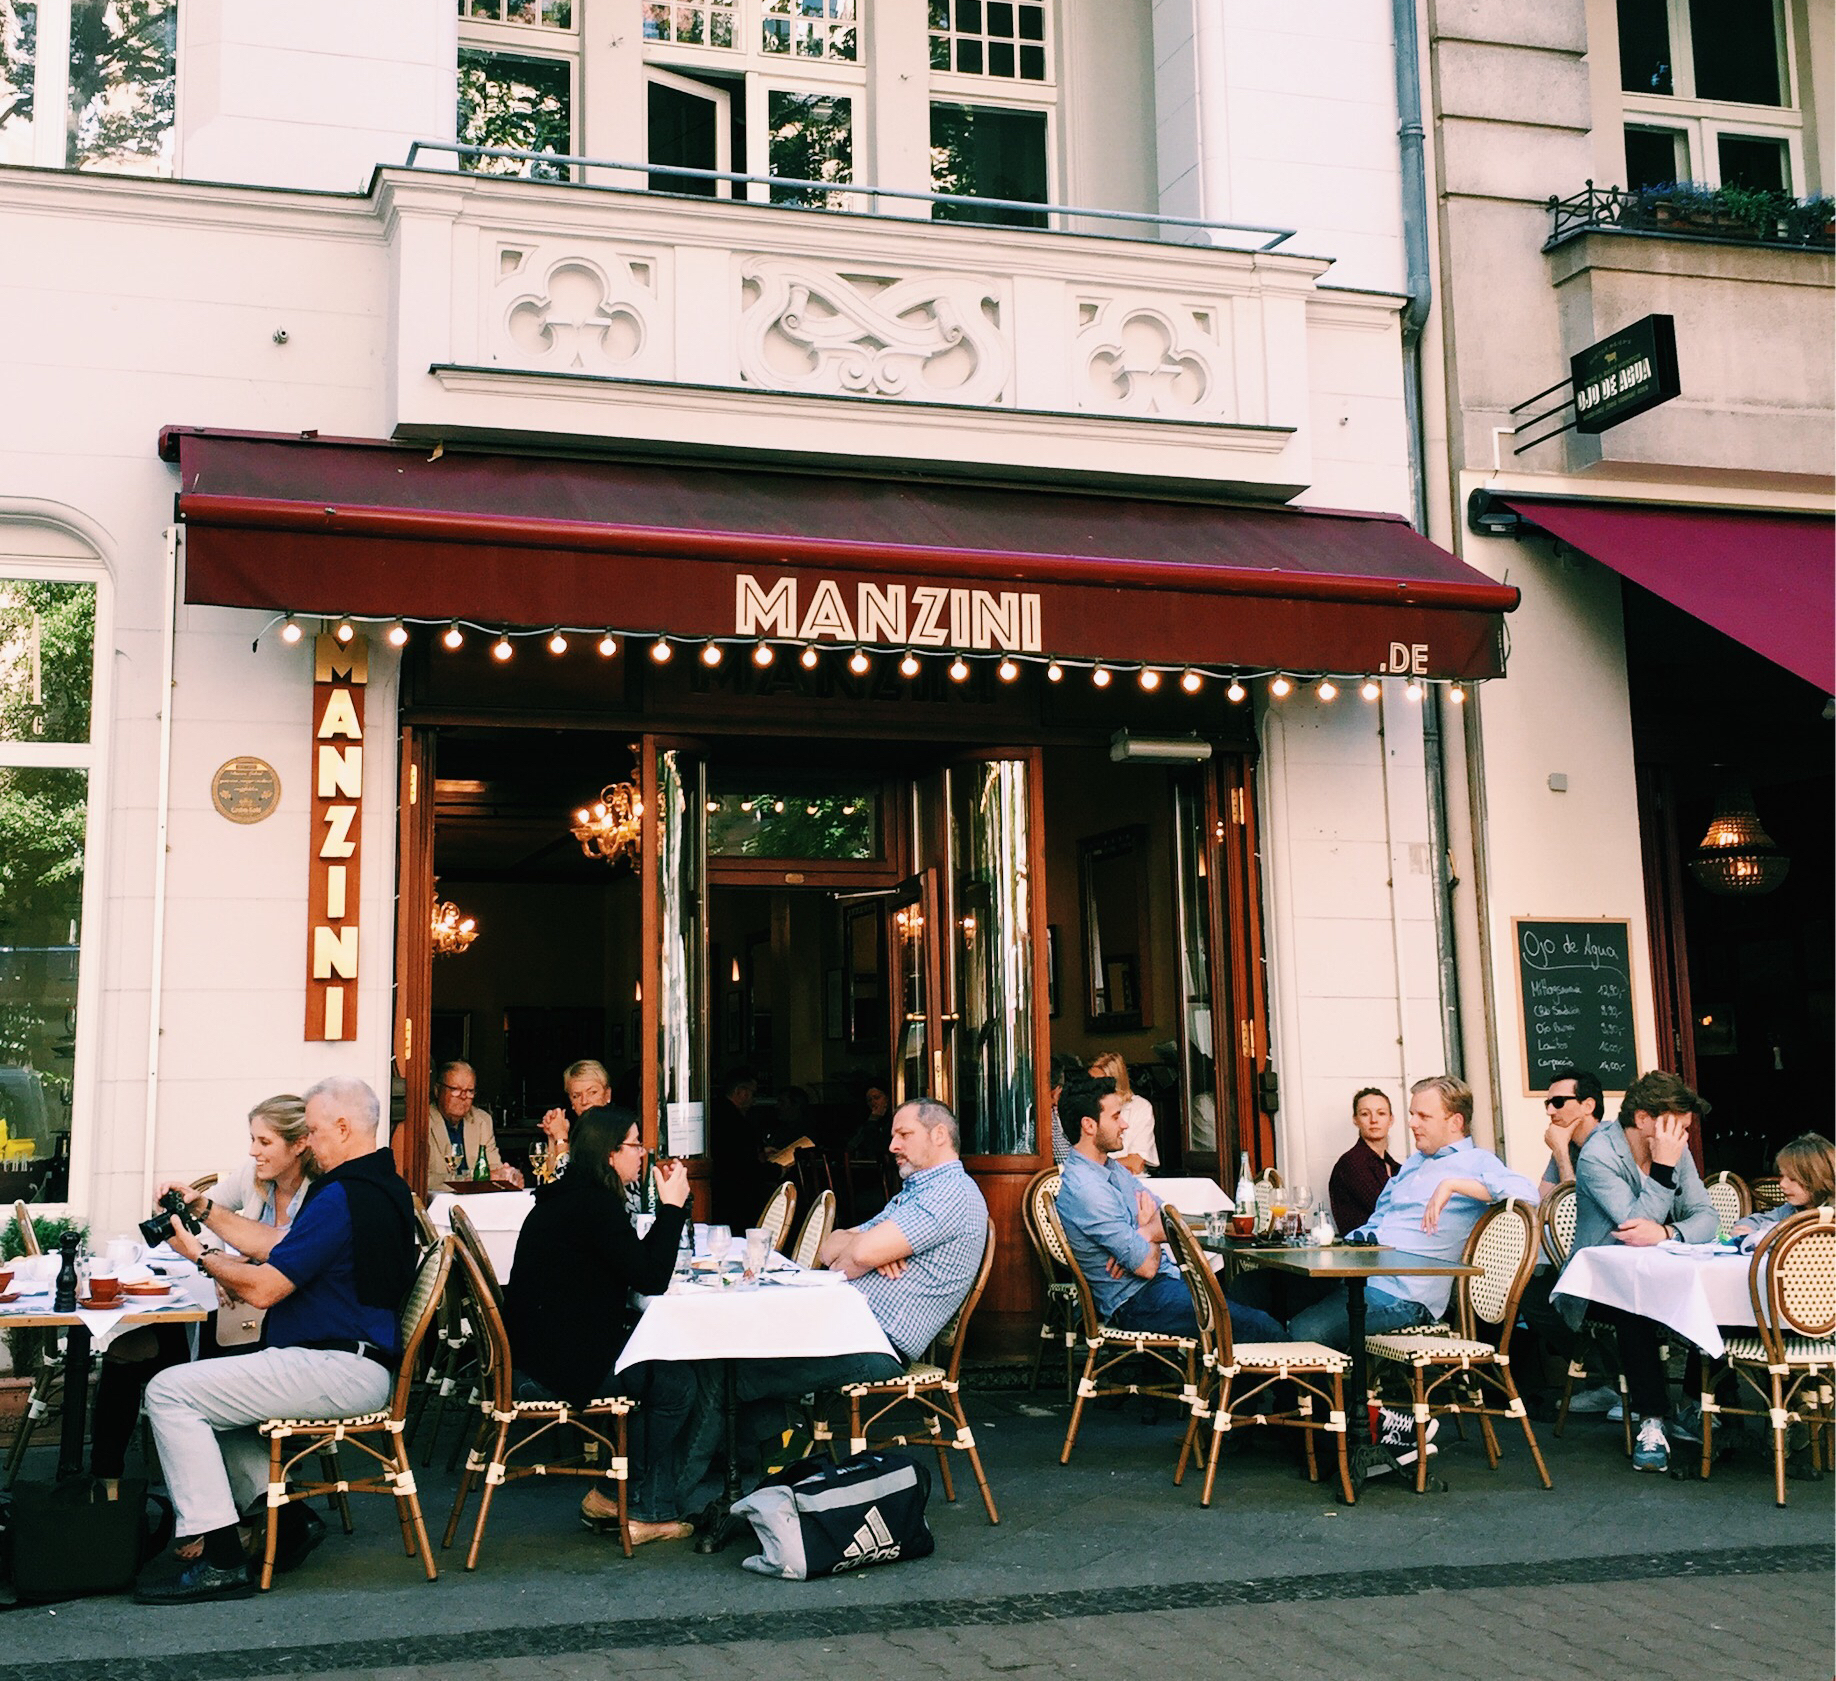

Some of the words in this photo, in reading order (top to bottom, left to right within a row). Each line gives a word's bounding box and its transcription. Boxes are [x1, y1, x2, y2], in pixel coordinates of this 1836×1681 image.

[1577, 383, 1600, 411] OJO
[1601, 373, 1618, 400] DE
[1619, 357, 1652, 392] AGUA
[735, 574, 1042, 652] MANZINI
[1379, 641, 1429, 675] .DE
[313, 633, 369, 1041] MANZINI
[1524, 931, 1556, 968] Ojo
[1563, 934, 1579, 955] de
[1584, 933, 1619, 970] Agua
[832, 1544, 901, 1573] adidas
